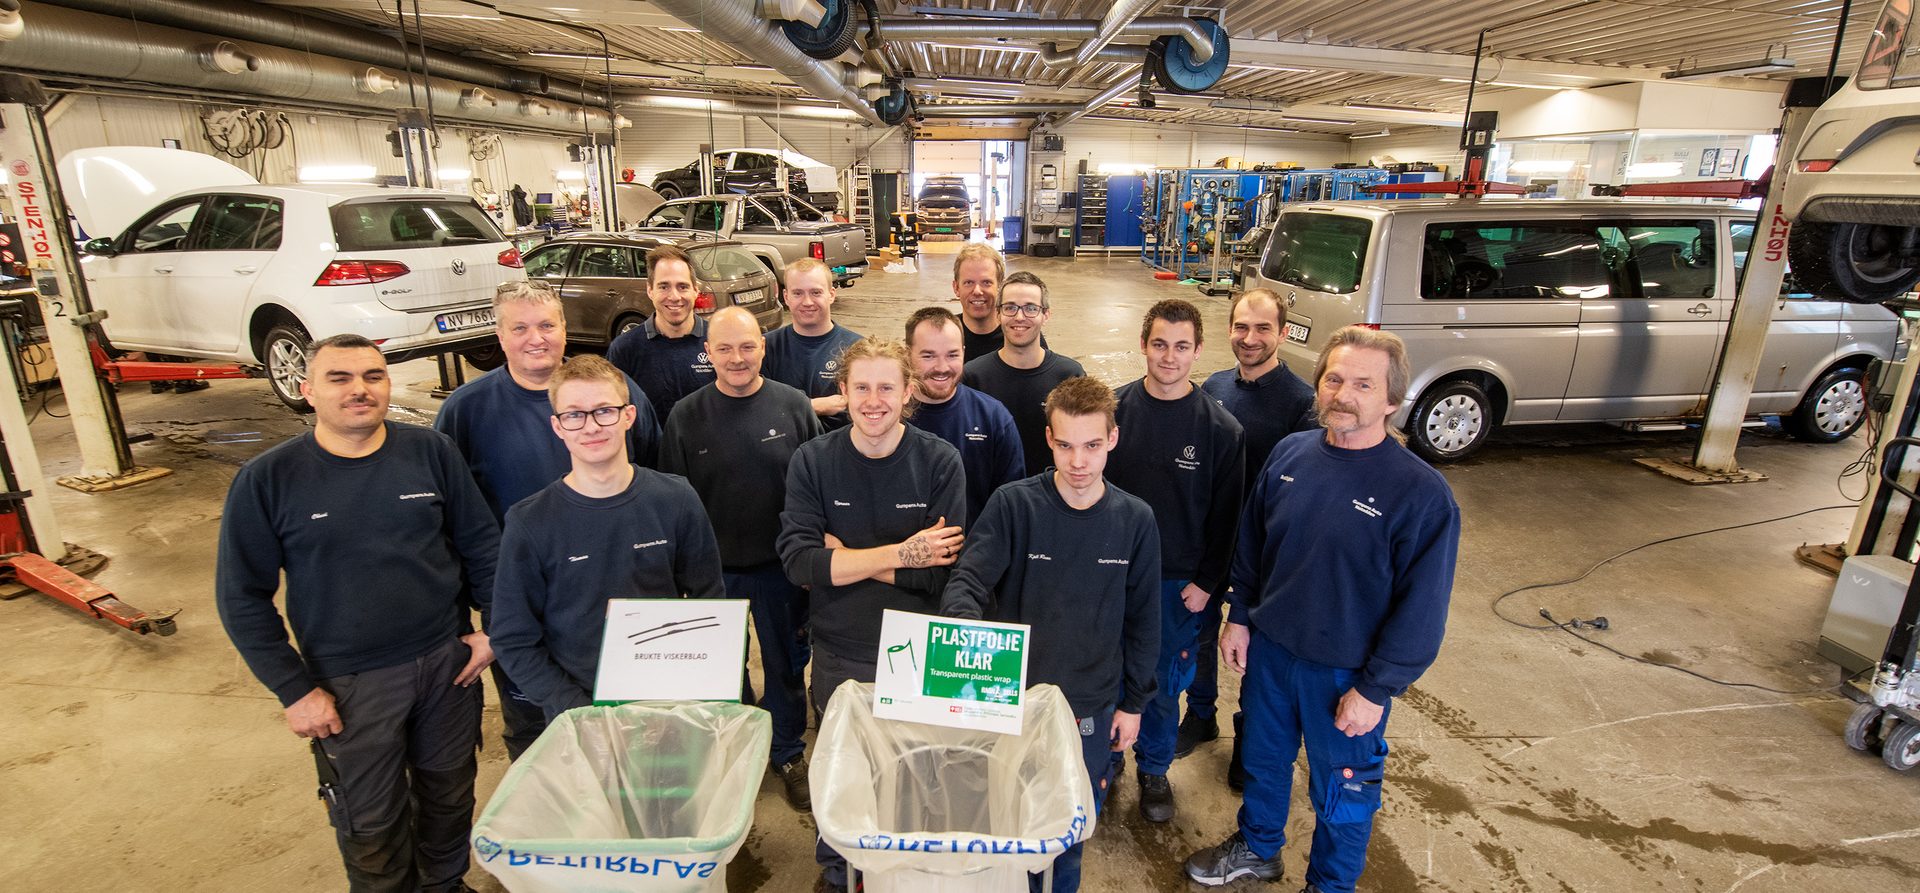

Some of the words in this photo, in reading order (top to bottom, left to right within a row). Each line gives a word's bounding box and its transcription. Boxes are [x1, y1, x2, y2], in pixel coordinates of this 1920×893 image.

[52, 302, 66, 317] 2
[447, 314, 464, 327] NV
[468, 310, 496, 324] 7661
[931, 626, 1021, 651] PLASTFOLIE
[955, 650, 993, 670] KLAR
[930, 668, 970, 681] Transparent
[970, 672, 993, 682] plastic
[993, 676, 1012, 684] wrap
